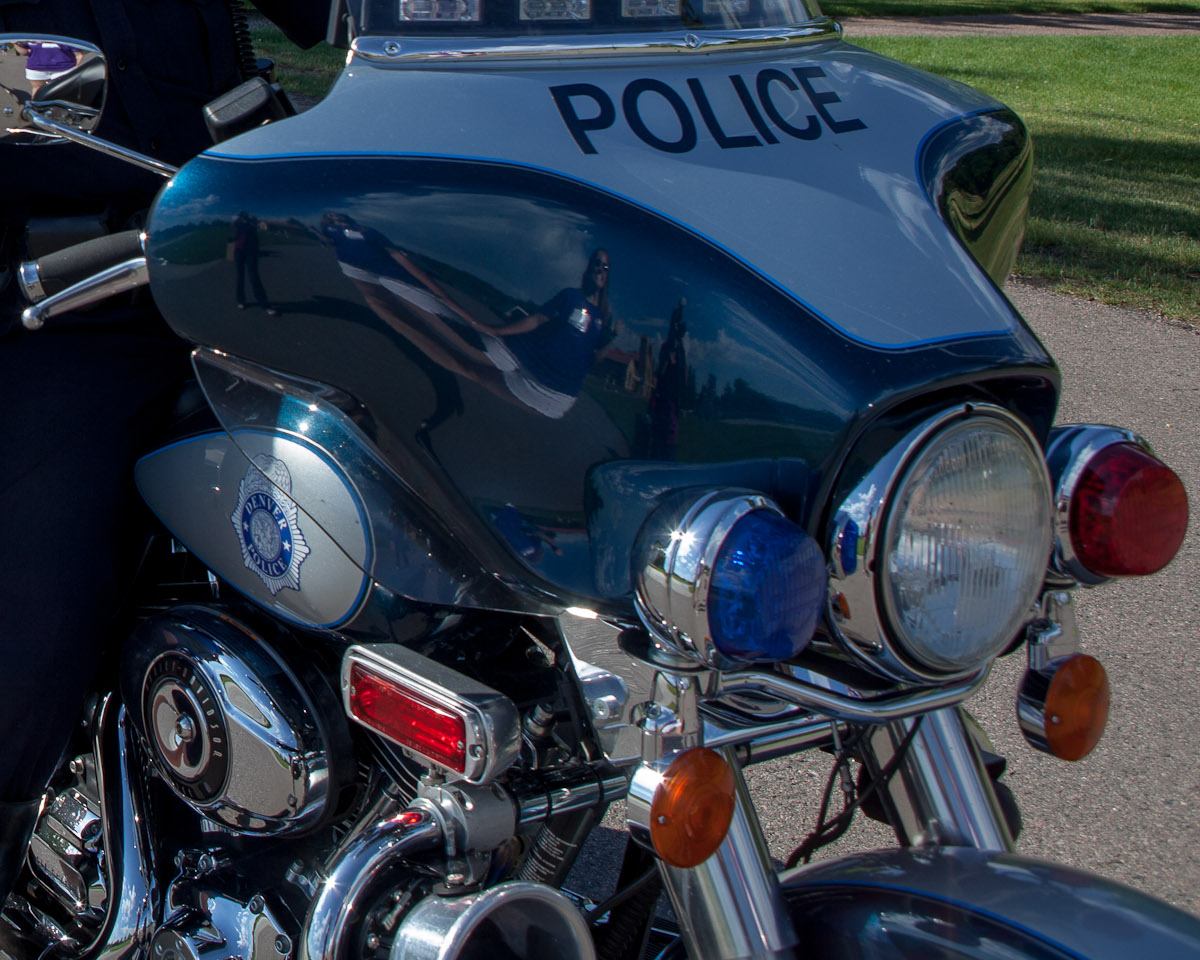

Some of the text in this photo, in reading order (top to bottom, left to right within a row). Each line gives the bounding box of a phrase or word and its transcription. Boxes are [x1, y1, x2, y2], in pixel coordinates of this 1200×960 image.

[548, 66, 868, 155] POLICE
[244, 494, 288, 530] DENVER
[247, 543, 288, 576] POLICE
